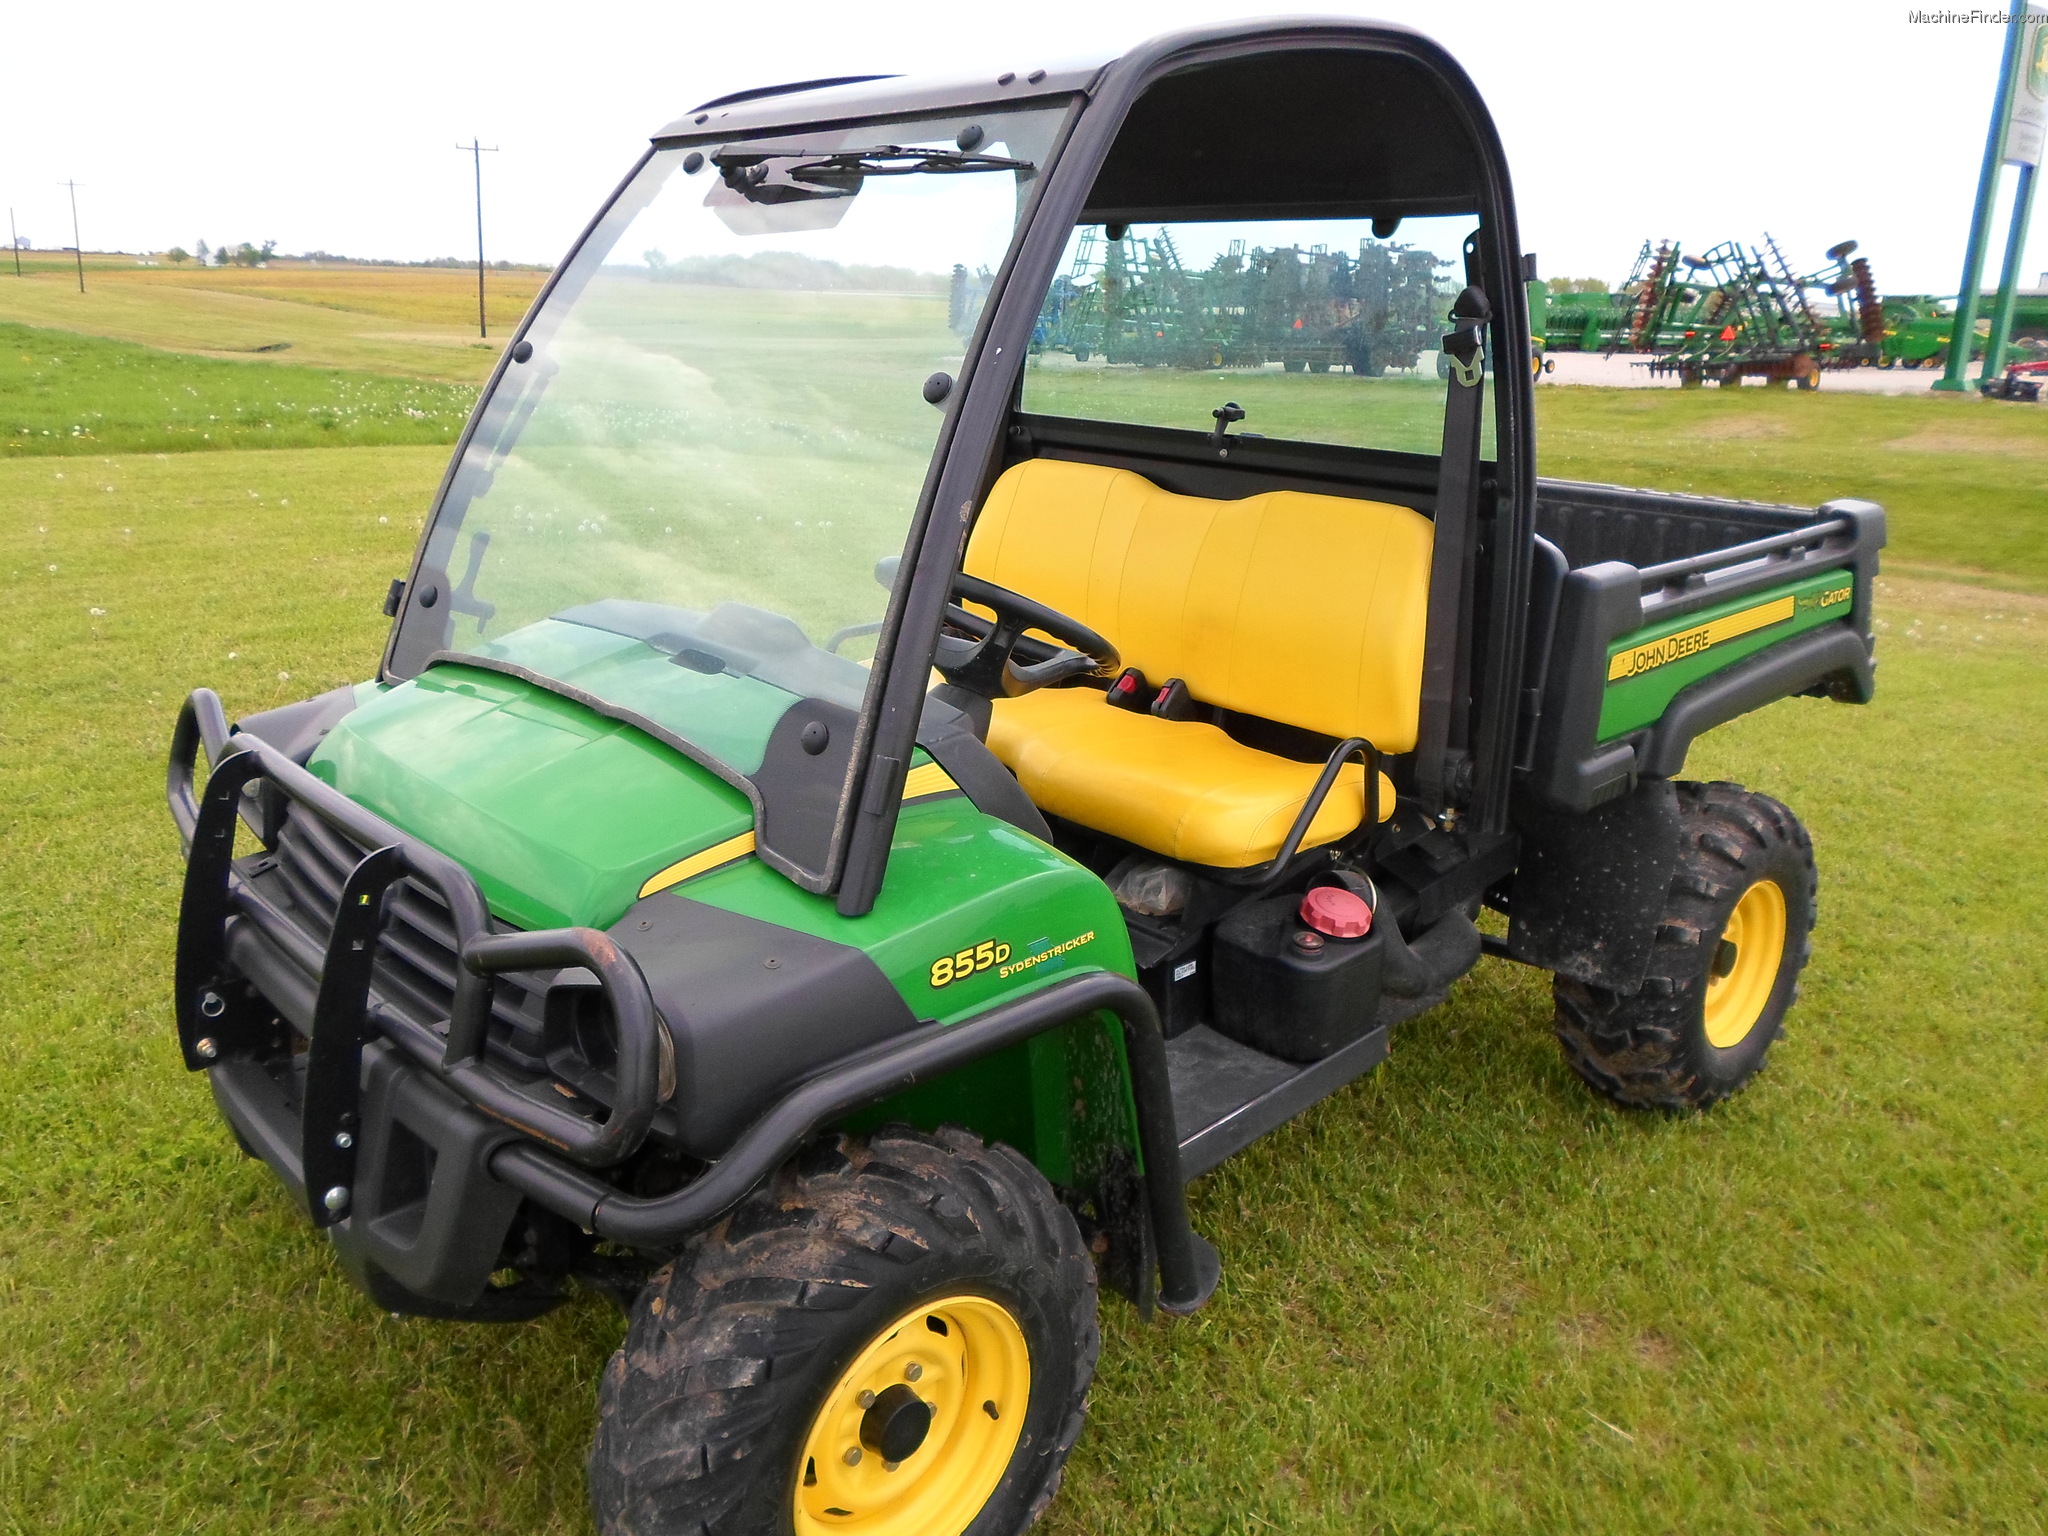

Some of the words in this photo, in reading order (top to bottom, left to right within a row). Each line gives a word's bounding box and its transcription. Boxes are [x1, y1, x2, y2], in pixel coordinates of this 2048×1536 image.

[1820, 587, 1851, 608] GATOR
[1627, 645, 1666, 675] JOHN
[1667, 629, 1711, 660] DEERE
[930, 939, 1011, 988] 855D
[999, 931, 1095, 979] SYDENSTRICKER
